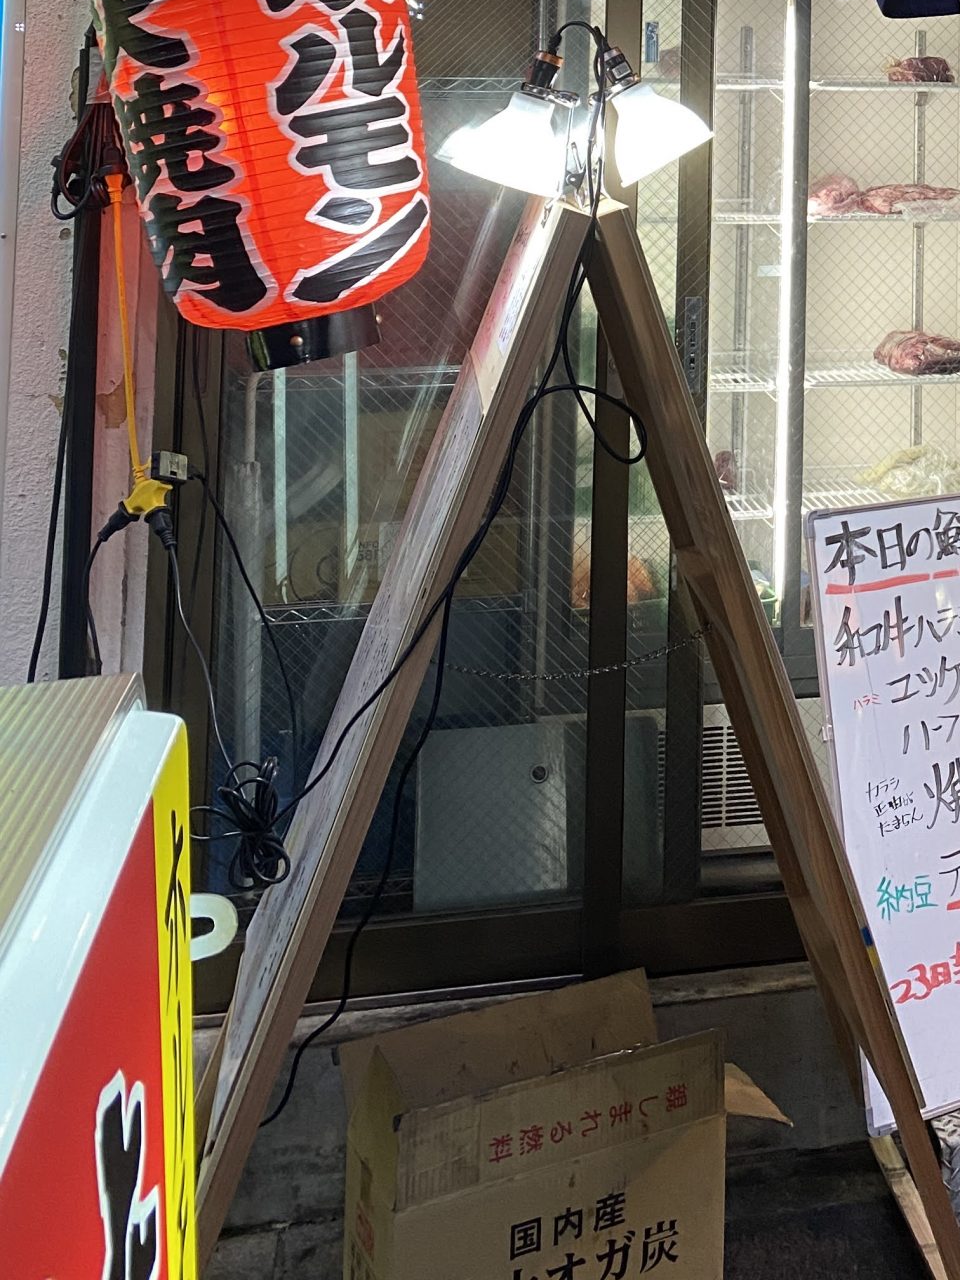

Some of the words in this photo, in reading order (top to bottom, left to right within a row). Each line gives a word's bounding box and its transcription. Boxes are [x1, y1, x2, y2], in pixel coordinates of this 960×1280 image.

[876, 874, 939, 924] 納豆
[509, 1192, 627, 1261] 国内産
[512, 1219, 680, 1280] オガ炭
